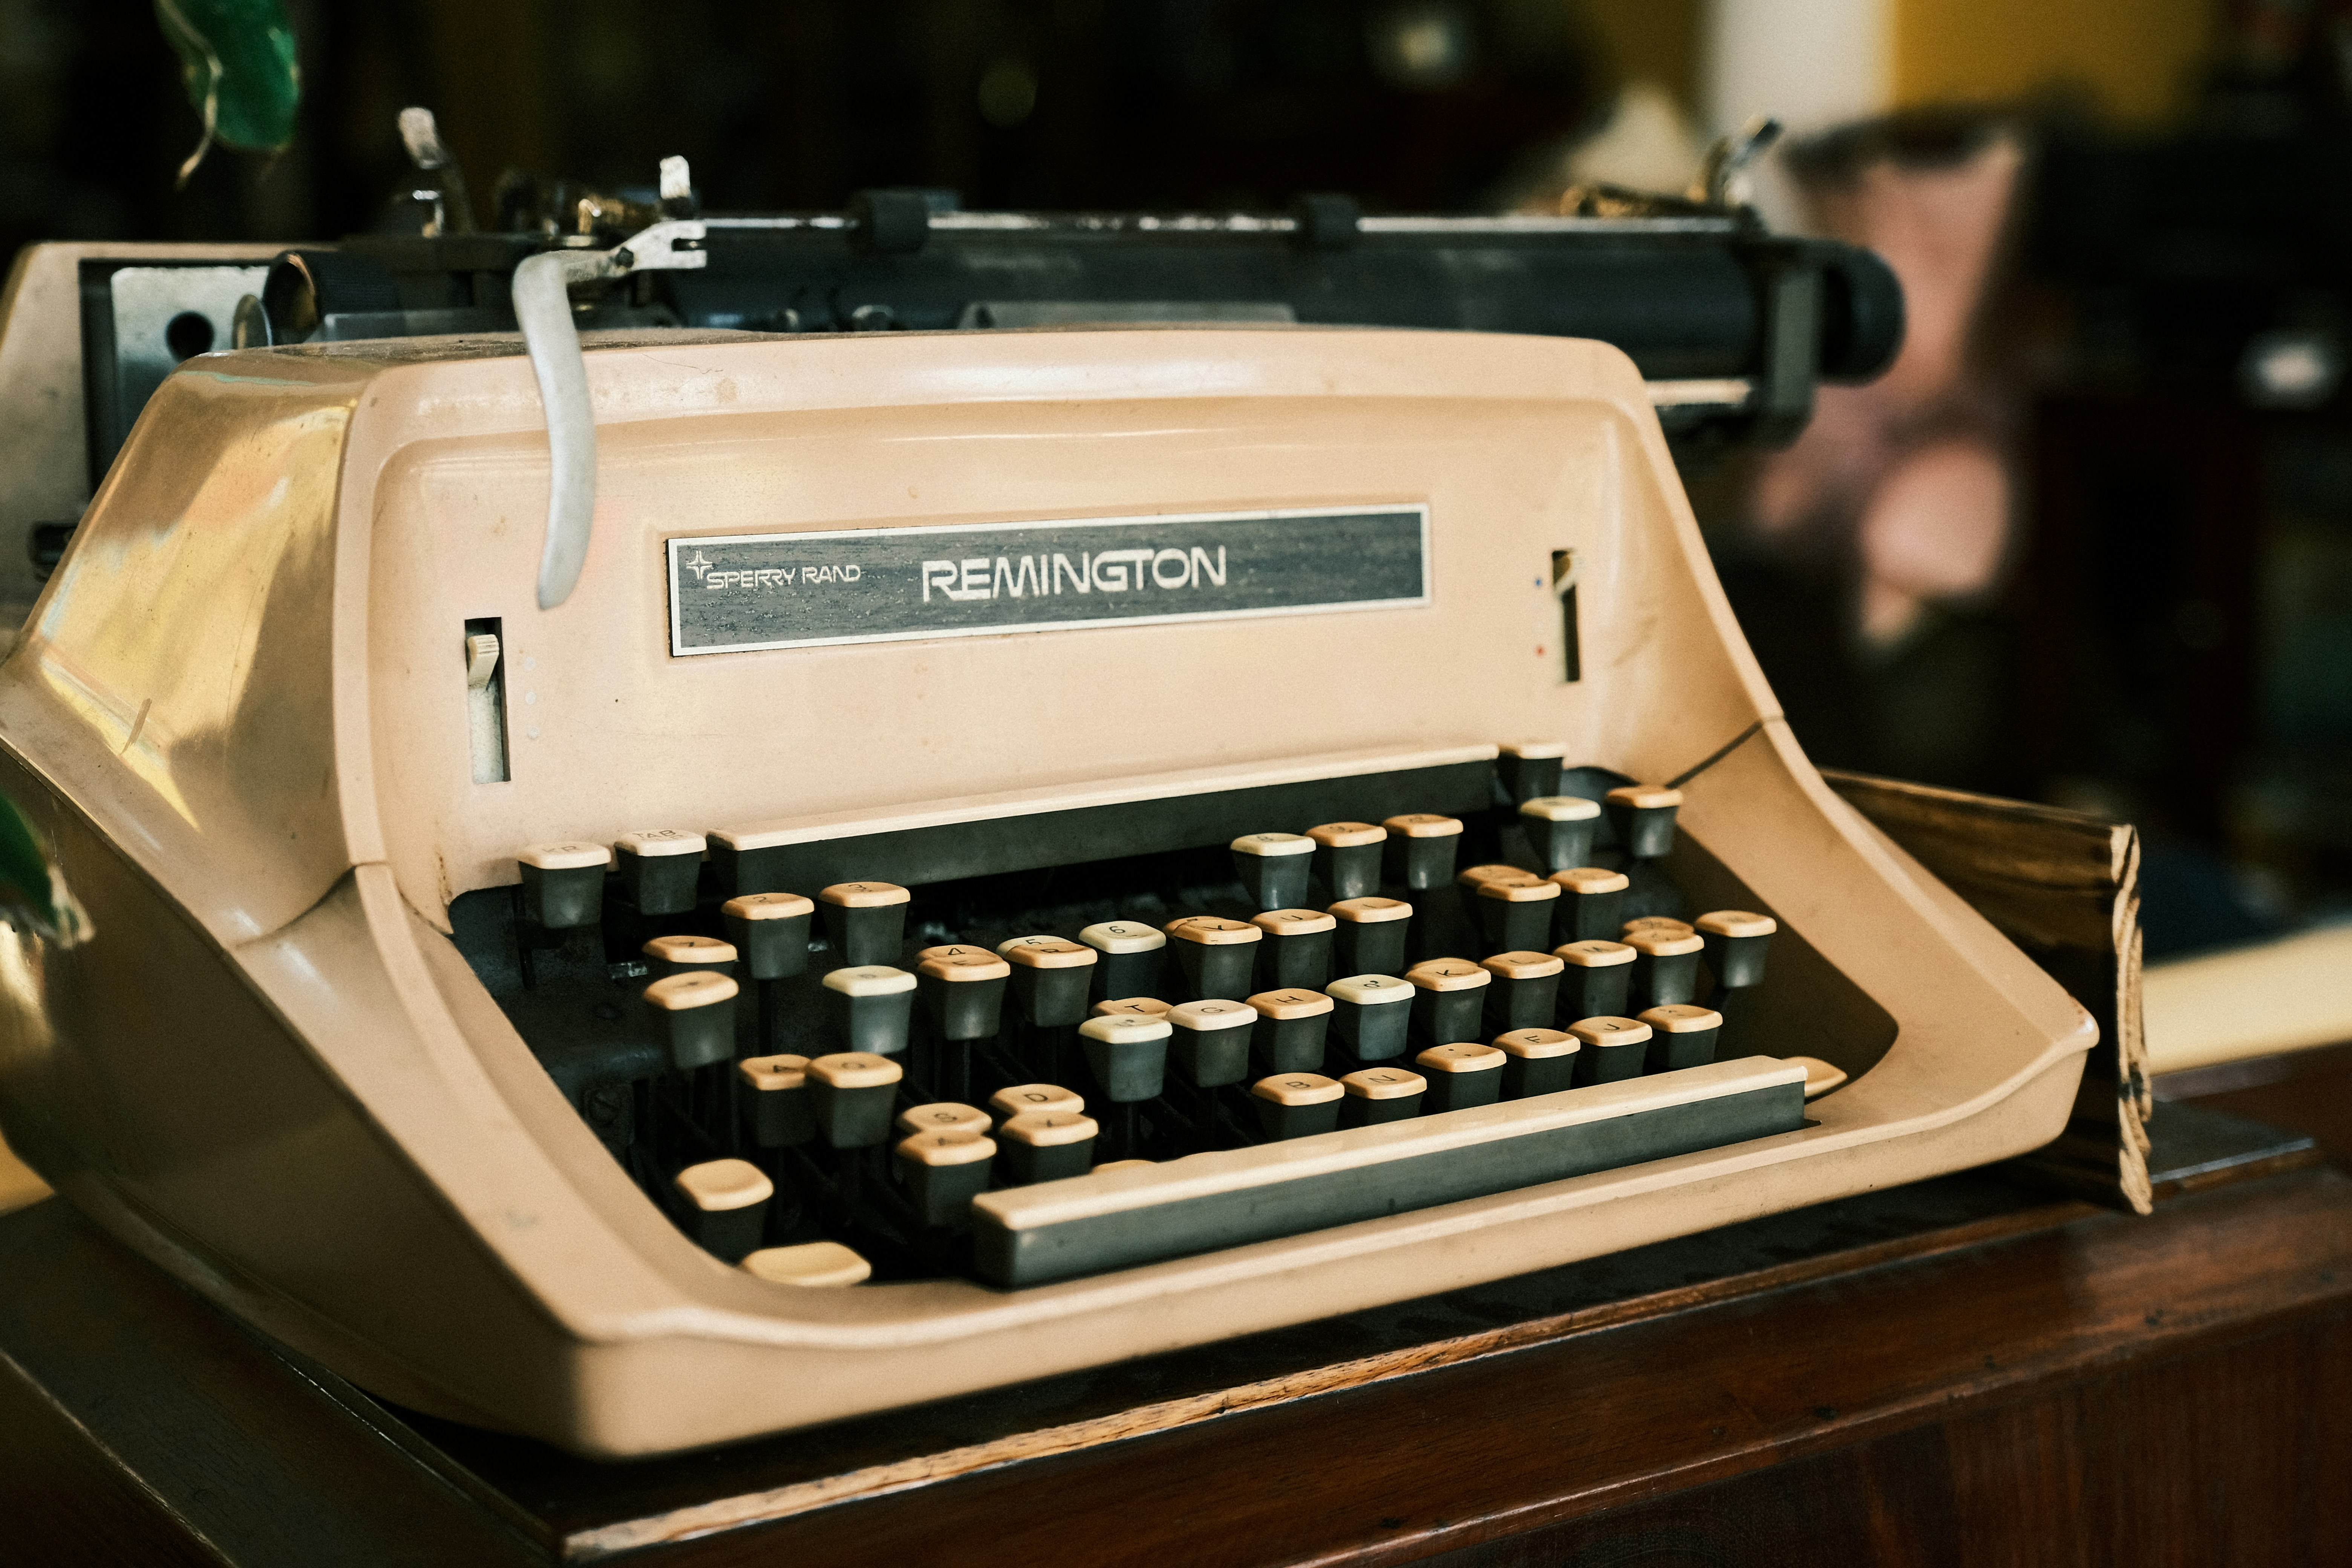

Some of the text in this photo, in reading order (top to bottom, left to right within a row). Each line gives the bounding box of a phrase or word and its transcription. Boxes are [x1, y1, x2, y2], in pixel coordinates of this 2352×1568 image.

[707, 565, 861, 589] SPERRY RAND
[922, 544, 1227, 603] REMINGTON
[633, 830, 677, 839] TAB
[1109, 925, 1126, 934] 6
[948, 947, 966, 956] 4
[1275, 995, 1304, 1004] H
[1124, 1004, 1145, 1013] T
[1603, 1023, 1620, 1031] J
[1524, 1035, 1541, 1043] F
[1367, 1075, 1398, 1084] N
[1286, 1081, 1311, 1089] B
[1024, 1093, 1049, 1102] D
